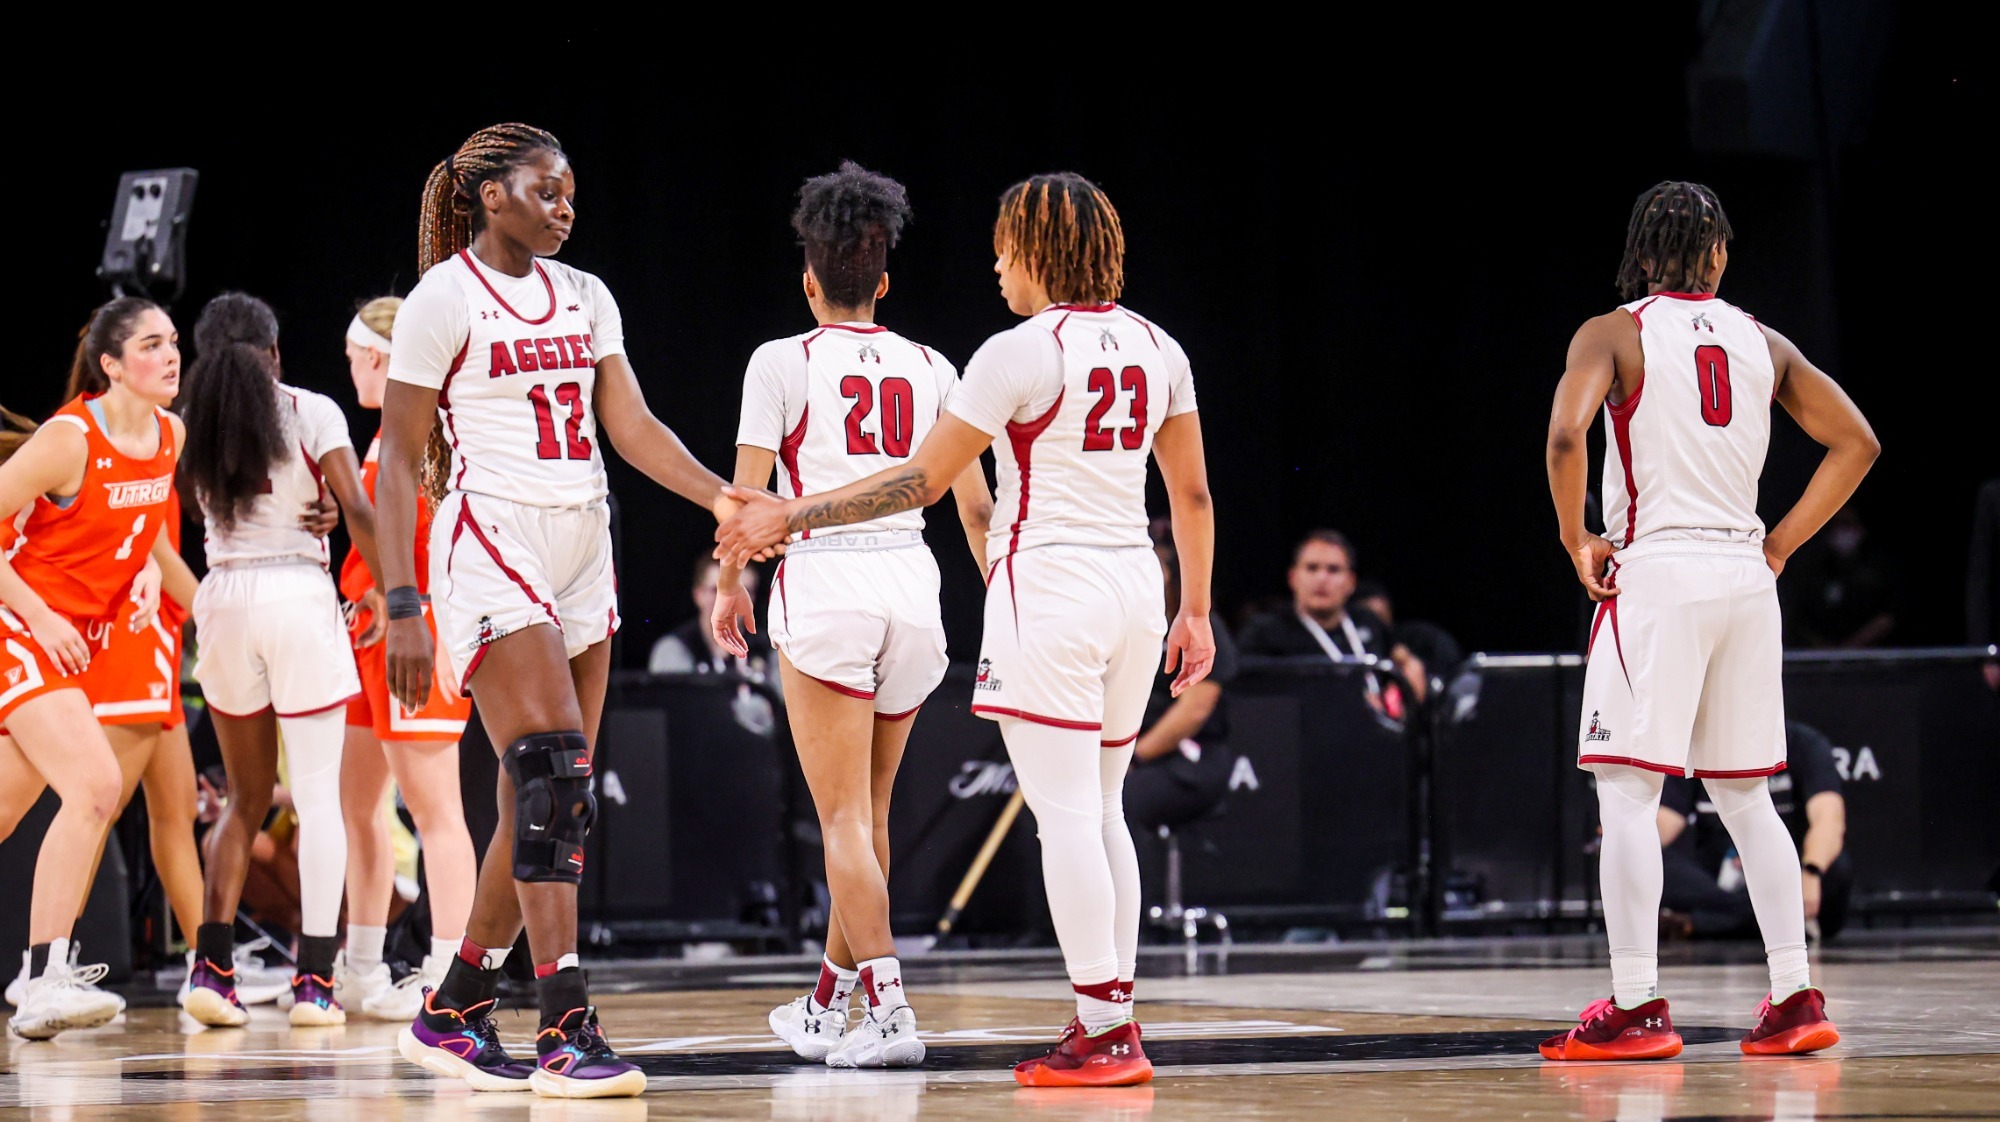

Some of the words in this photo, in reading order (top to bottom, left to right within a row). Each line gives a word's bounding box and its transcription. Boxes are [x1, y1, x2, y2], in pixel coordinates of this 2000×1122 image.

[527, 382, 592, 461] 12
[840, 375, 914, 458] 20
[1082, 365, 1148, 452] 23
[1694, 344, 1733, 428] 0
[115, 513, 146, 560] 1
